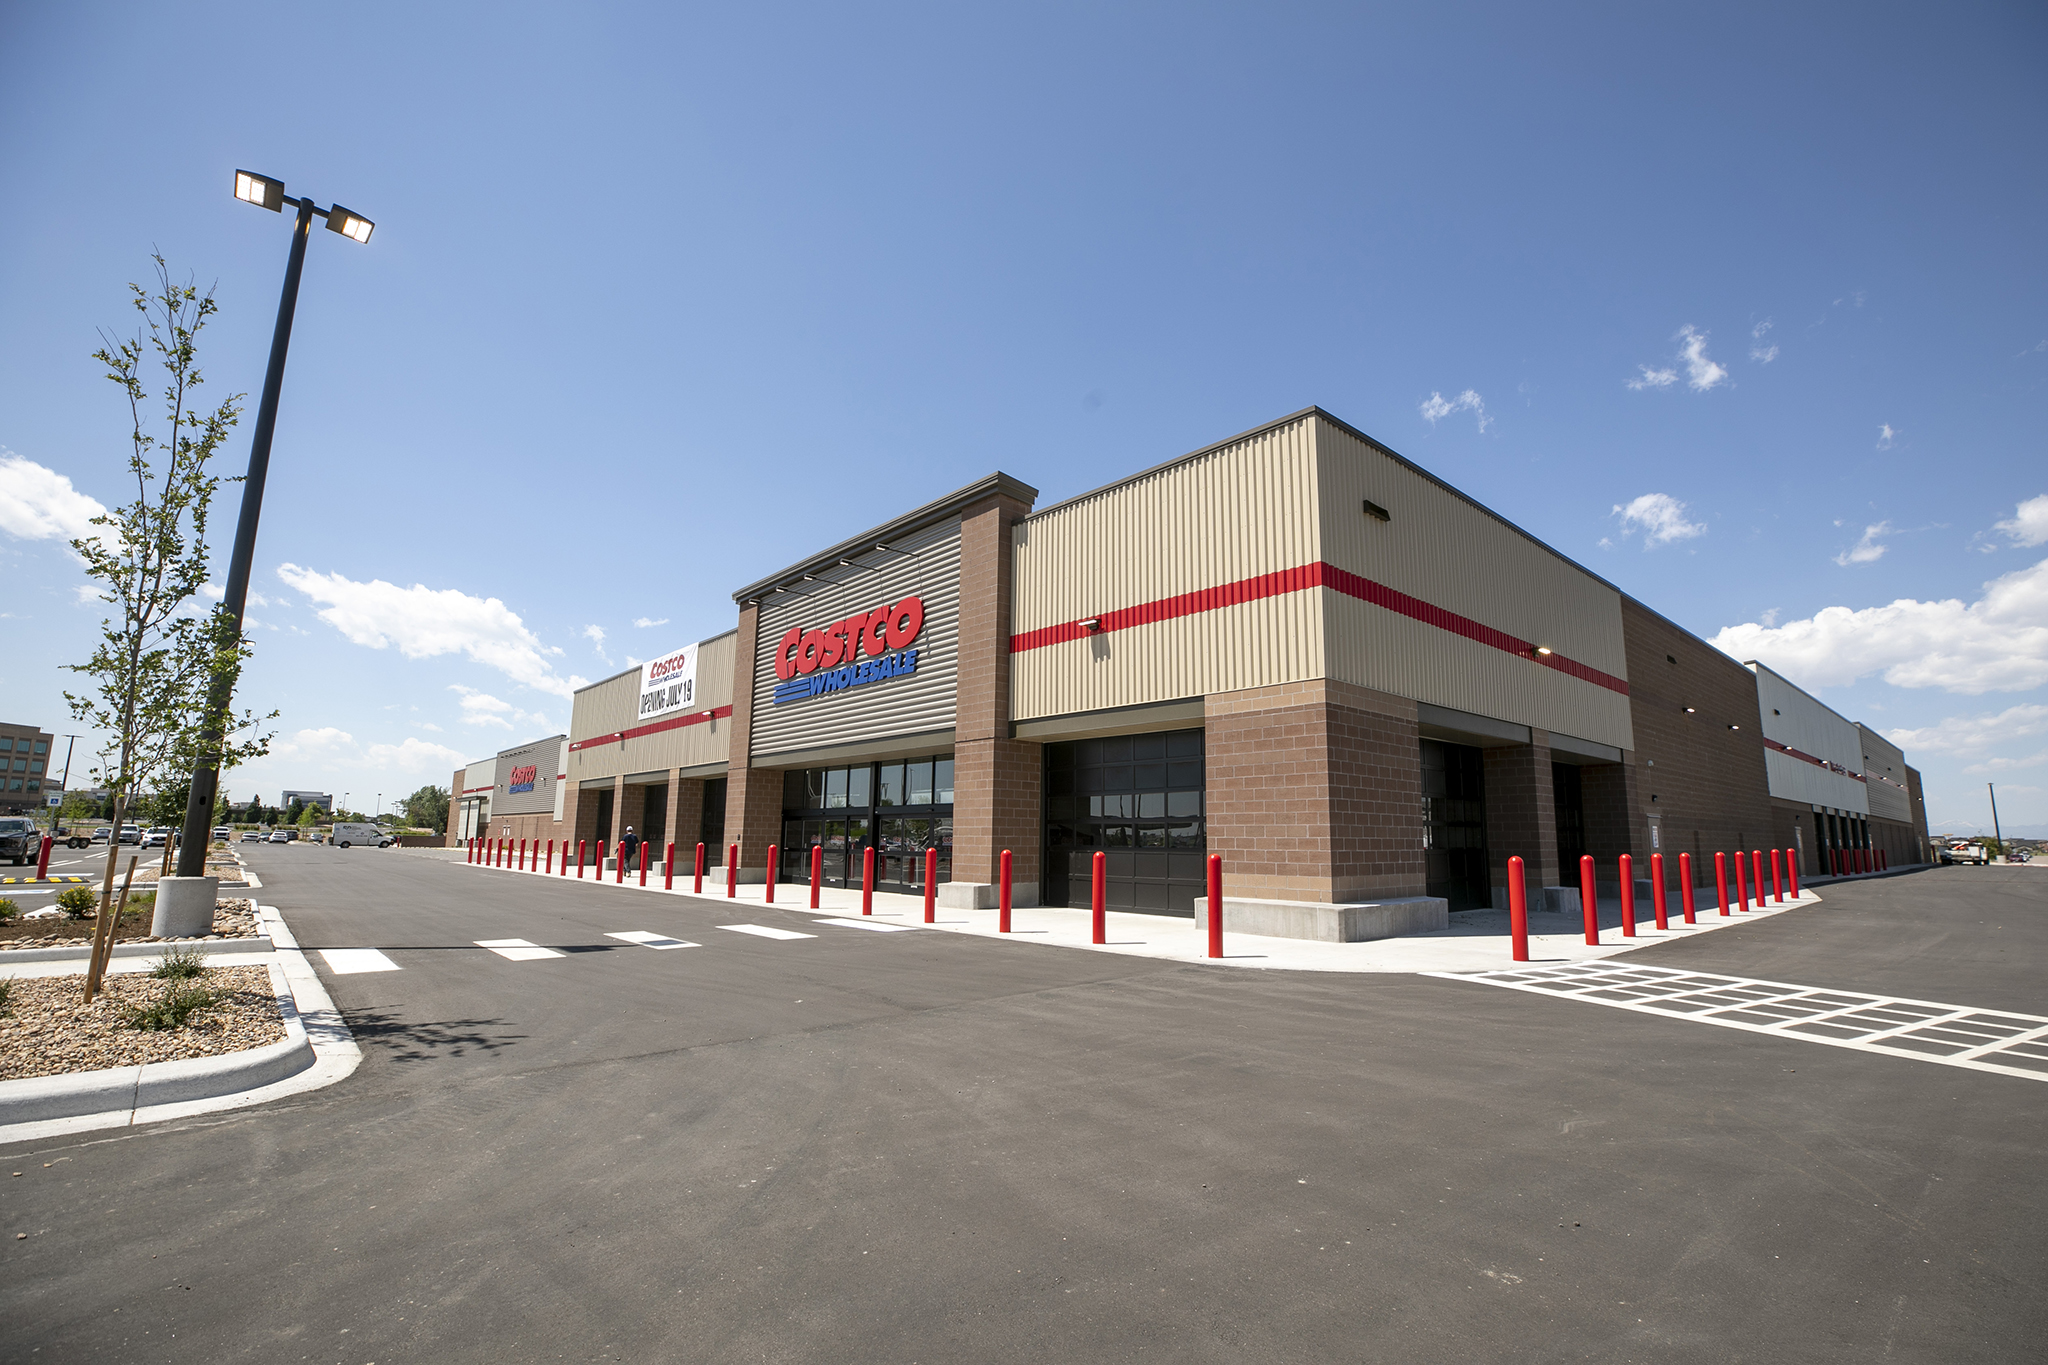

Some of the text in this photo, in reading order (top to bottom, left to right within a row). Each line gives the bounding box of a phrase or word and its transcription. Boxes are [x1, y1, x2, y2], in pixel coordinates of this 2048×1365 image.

[774, 596, 925, 681] COSTCO
[650, 654, 685, 679] COSTCO
[809, 649, 919, 697] WHOLESALE
[640, 679, 692, 714] OPENING JULY 19
[510, 765, 536, 785] COSTCO
